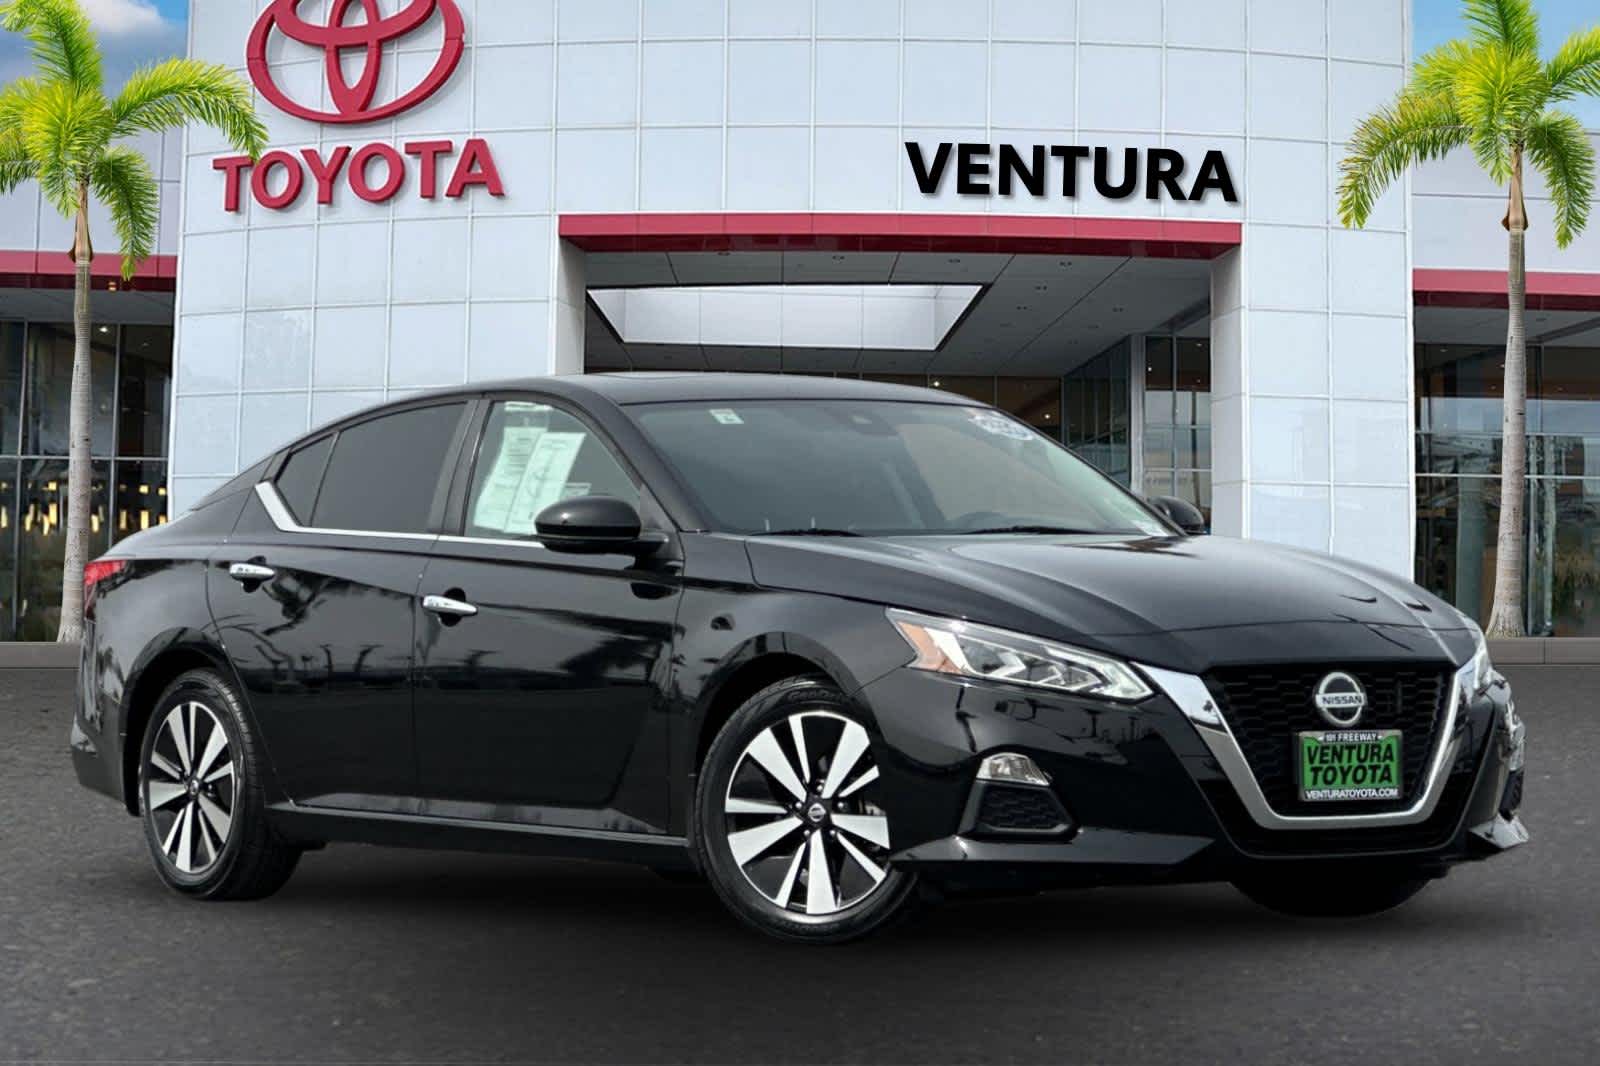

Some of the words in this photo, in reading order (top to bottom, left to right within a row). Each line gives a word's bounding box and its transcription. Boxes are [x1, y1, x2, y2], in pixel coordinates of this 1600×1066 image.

[212, 138, 505, 213] TOYOTA
[904, 141, 1239, 203] VENTURA
[1322, 695, 1361, 704] NISSAN
[1338, 733, 1377, 741] FREEWAY
[1307, 743, 1394, 764] VENTURA
[1310, 764, 1393, 785] TOYOTA
[1306, 789, 1398, 799] VENTURATOYOTA.COM
